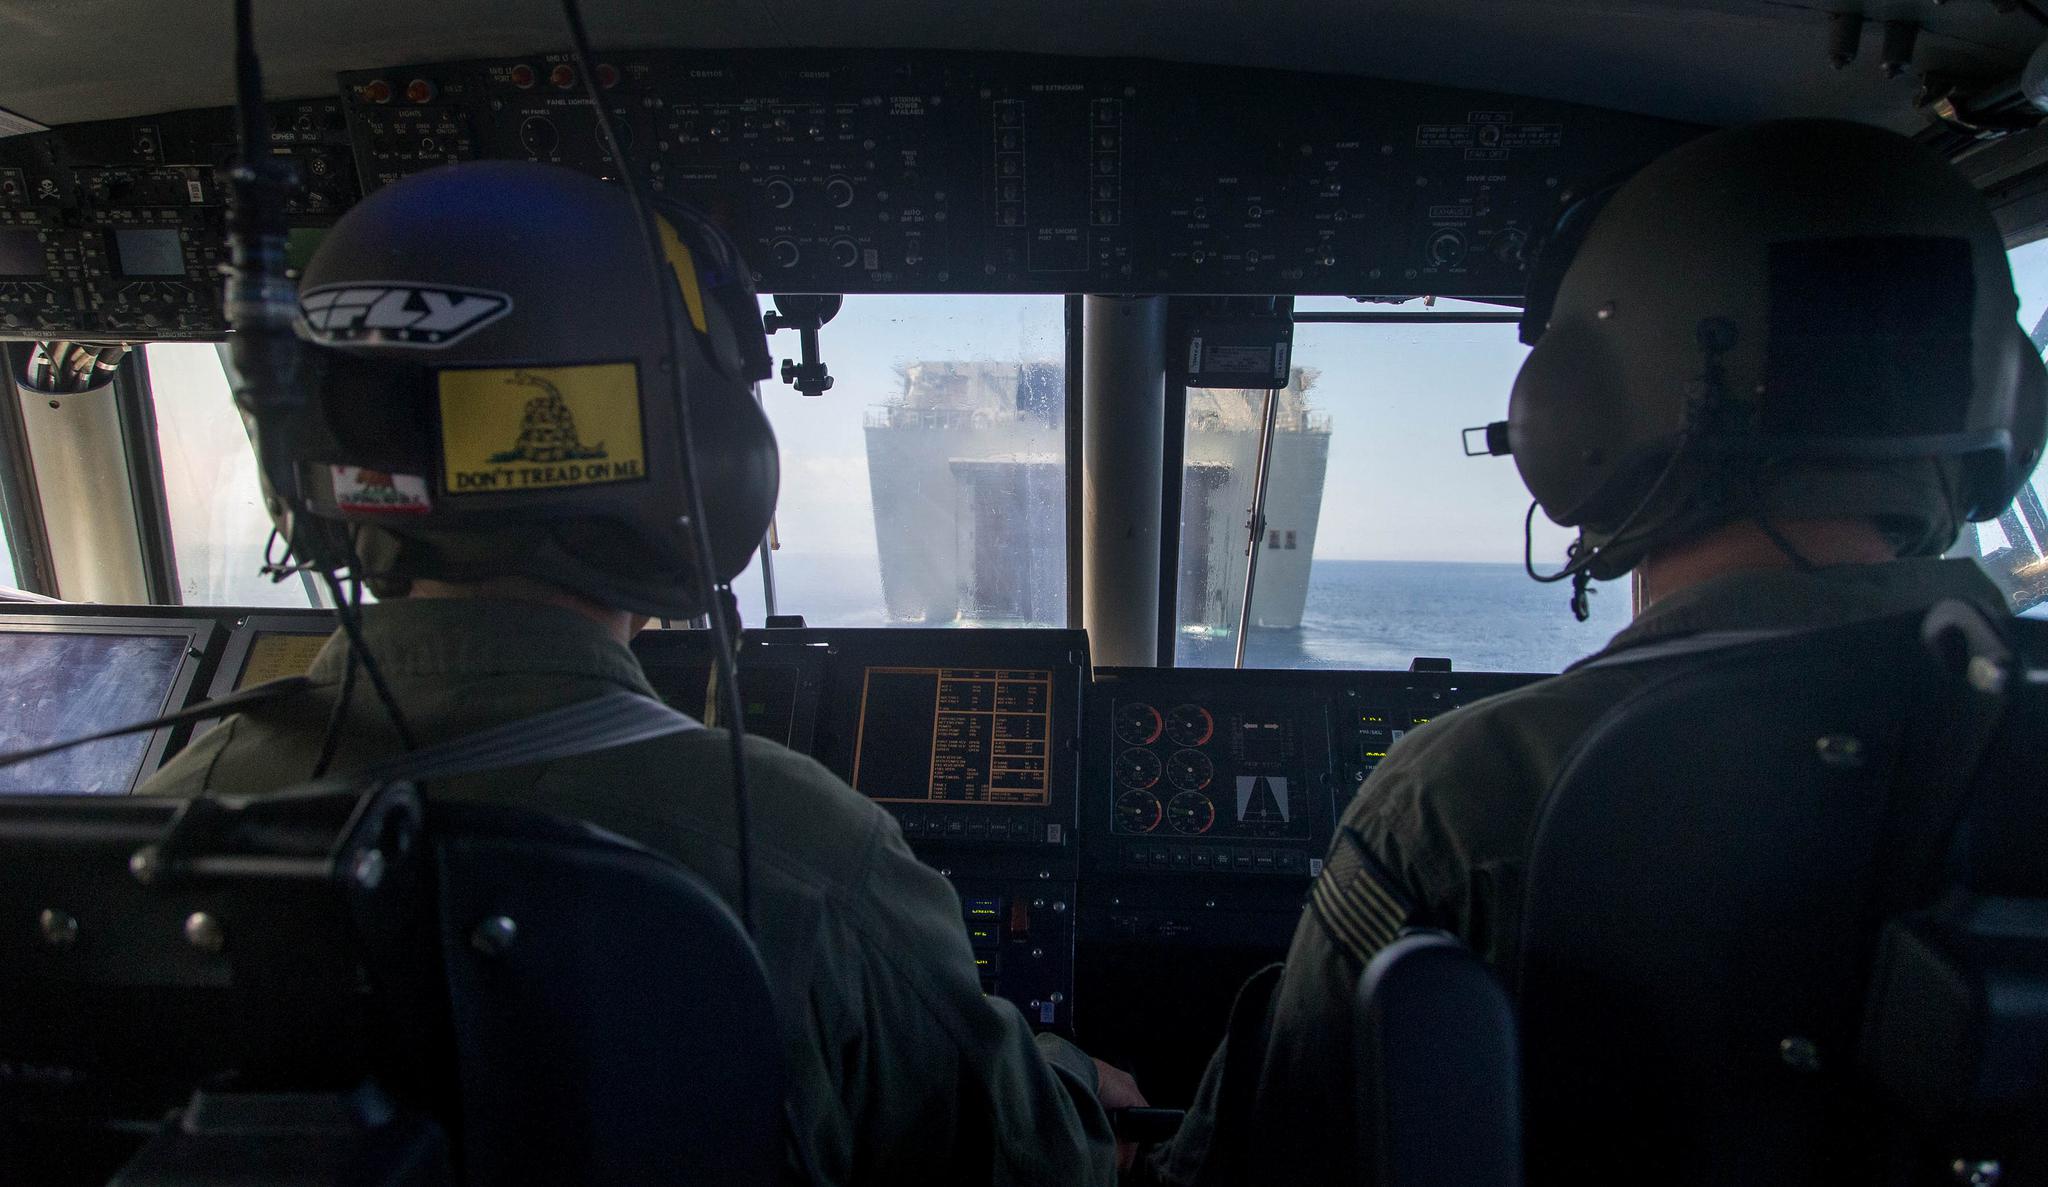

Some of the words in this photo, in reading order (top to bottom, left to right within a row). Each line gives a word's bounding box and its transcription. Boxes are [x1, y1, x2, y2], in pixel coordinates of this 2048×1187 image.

[301, 286, 508, 332] FLY
[456, 469, 514, 488] DON'T
[520, 465, 581, 485] TREAD
[586, 463, 609, 479] ON
[614, 460, 639, 477] ME
